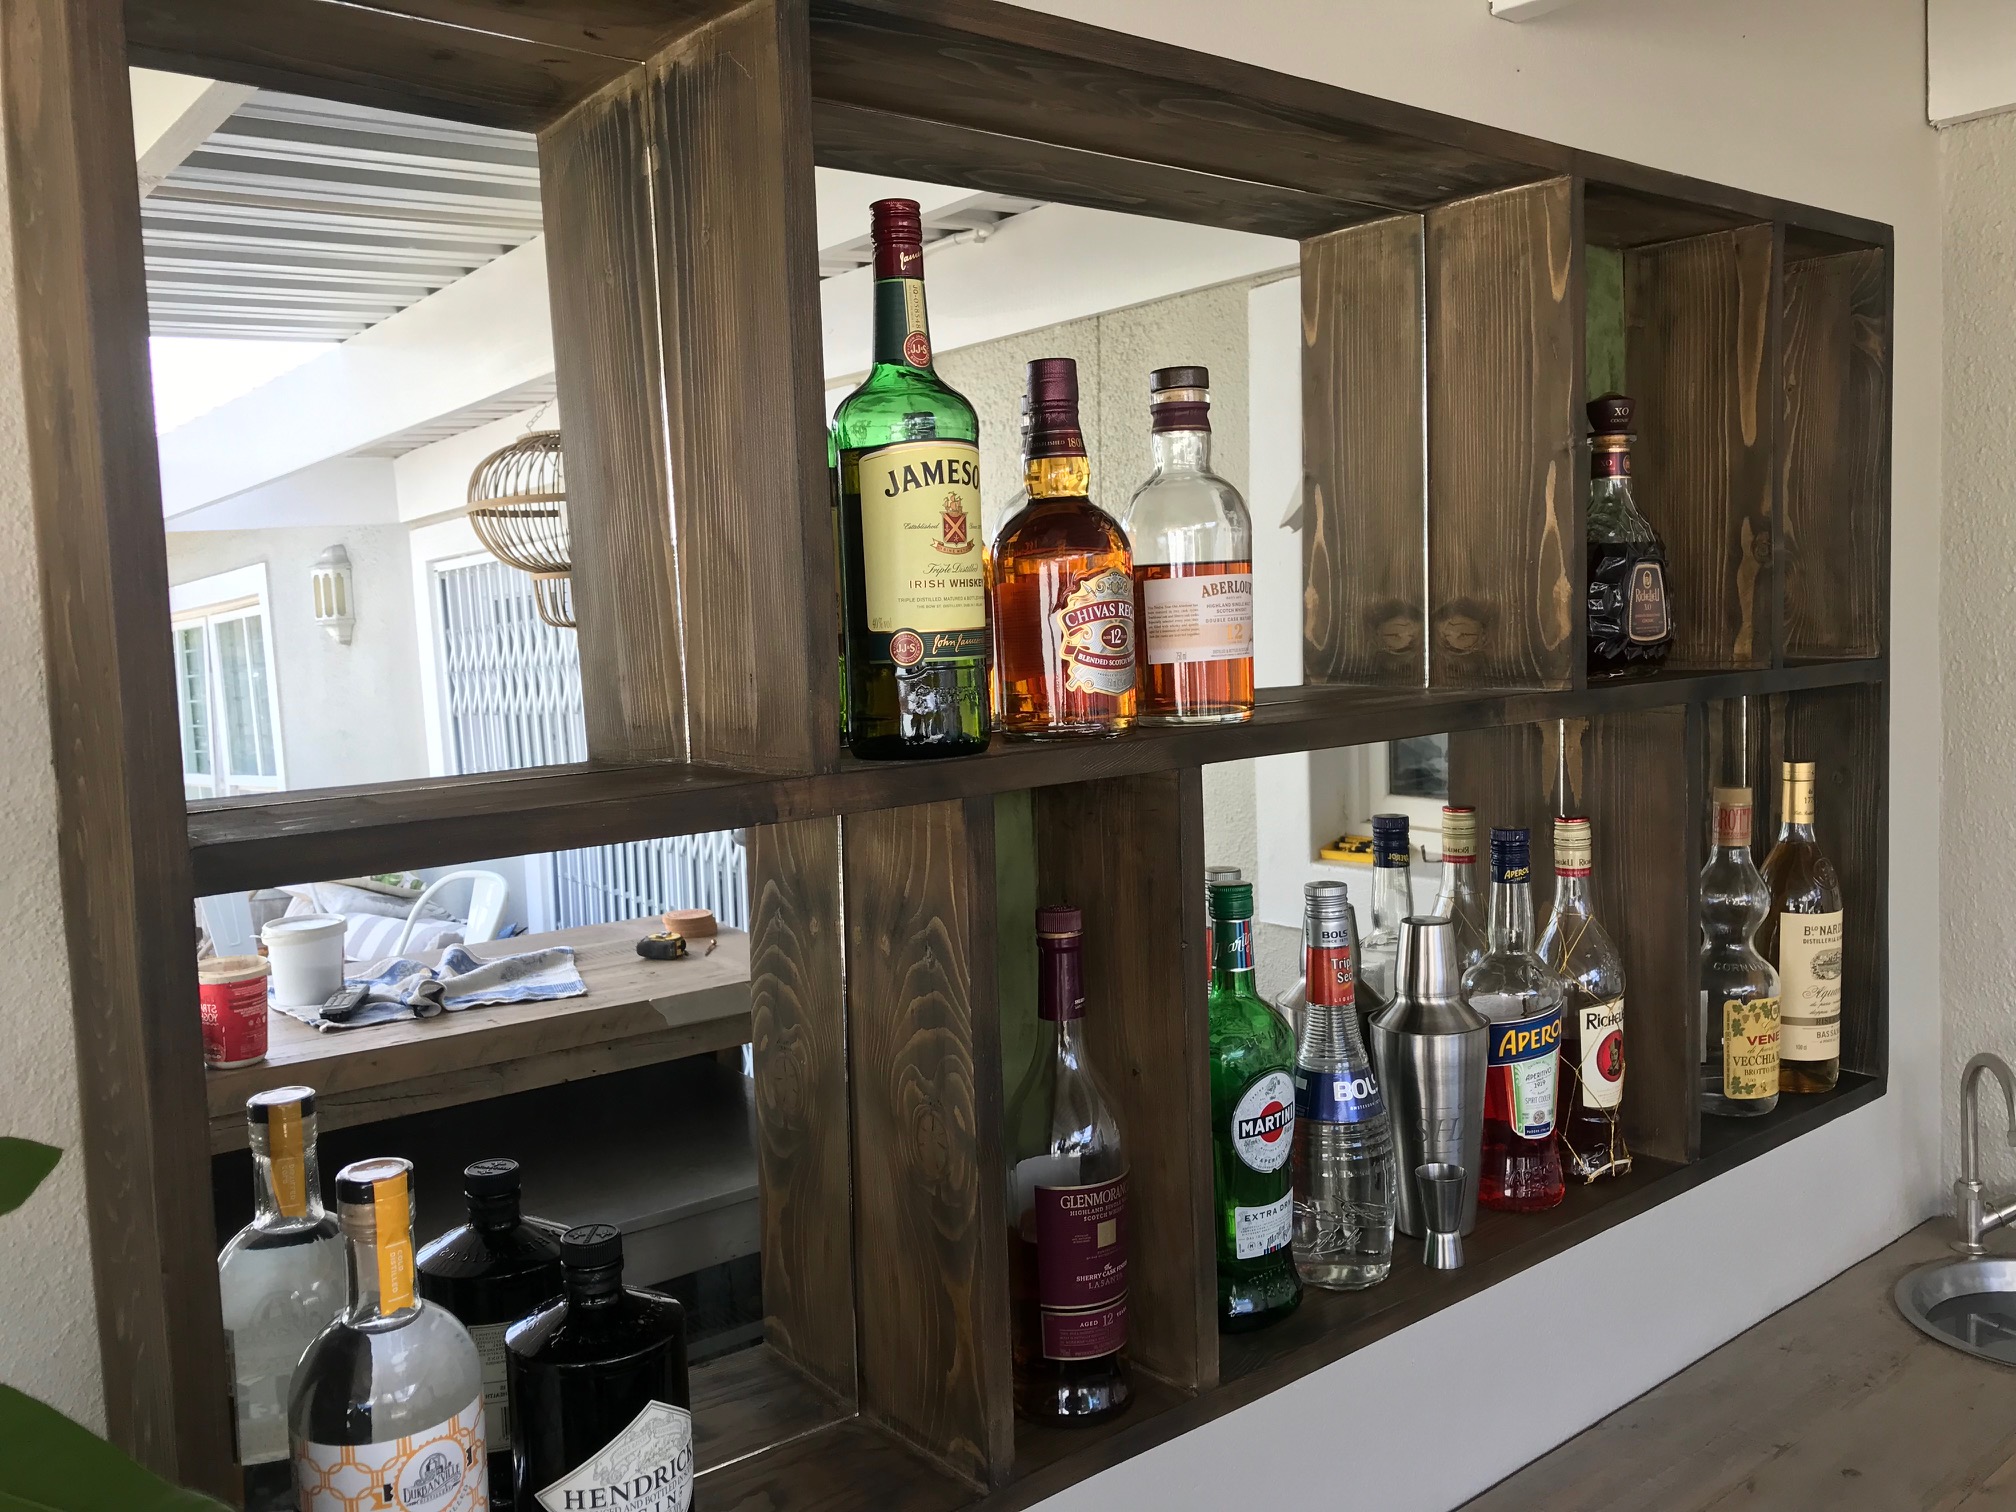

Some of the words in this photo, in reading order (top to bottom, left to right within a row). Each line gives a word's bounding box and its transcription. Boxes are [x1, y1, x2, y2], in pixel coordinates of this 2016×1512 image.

[1614, 407, 1630, 416] XO
[884, 459, 980, 498] JAMESO
[923, 562, 952, 578] Triple
[952, 562, 979, 574] Distilled
[909, 579, 946, 589] IRISH
[1065, 602, 1116, 627] CHIVAS
[1111, 628, 1122, 644] 12
[1227, 623, 1244, 641] 12
[1077, 653, 1109, 666] BLENDED
[1504, 866, 1530, 880] APEROL
[1322, 930, 1347, 939] BOLS
[1330, 957, 1351, 970] Trip
[1746, 1030, 1780, 1046] VENE
[1733, 1053, 1776, 1067] VECCHIA
[1744, 1067, 1770, 1076] BROTTO
[1241, 1103, 1293, 1138] MARTINI
[1070, 1206, 1104, 1217] HIGHLAND
[1084, 1212, 1108, 1222] SCOTCH
[1244, 1208, 1278, 1222] EXTRA
[396, 1249, 404, 1273] COLD
[389, 1251, 398, 1294] DISTILLED
[1076, 1272, 1102, 1282] SHERRY
[1102, 1267, 1117, 1278] CASK
[1080, 1320, 1099, 1328] AGED
[1102, 1312, 1114, 1328] 12
[624, 1497, 644, 1512] AND
[645, 1478, 678, 1504] BOTTLED
